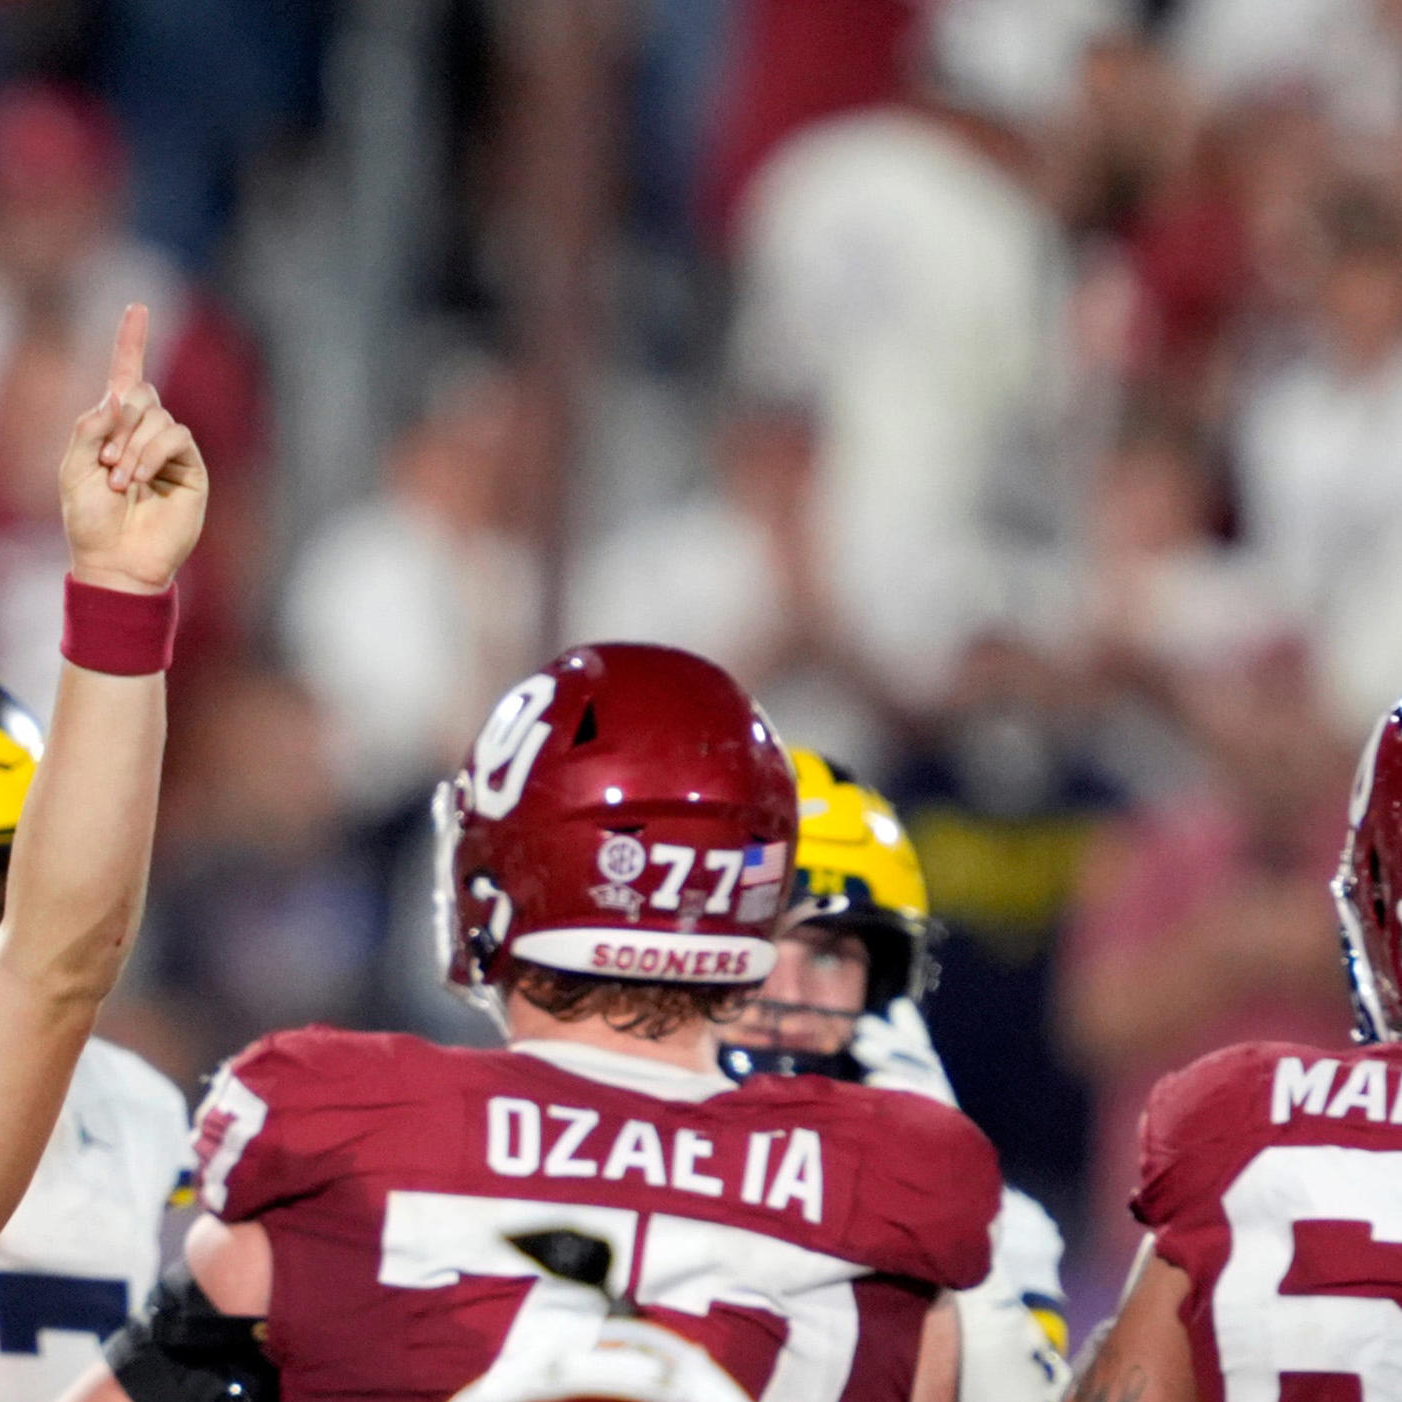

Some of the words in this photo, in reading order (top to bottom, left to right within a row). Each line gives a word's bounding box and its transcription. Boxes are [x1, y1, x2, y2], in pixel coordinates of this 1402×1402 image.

[650, 843, 744, 914] 77
[591, 943, 751, 976] SOONERS
[1270, 1057, 1402, 1126] MA
